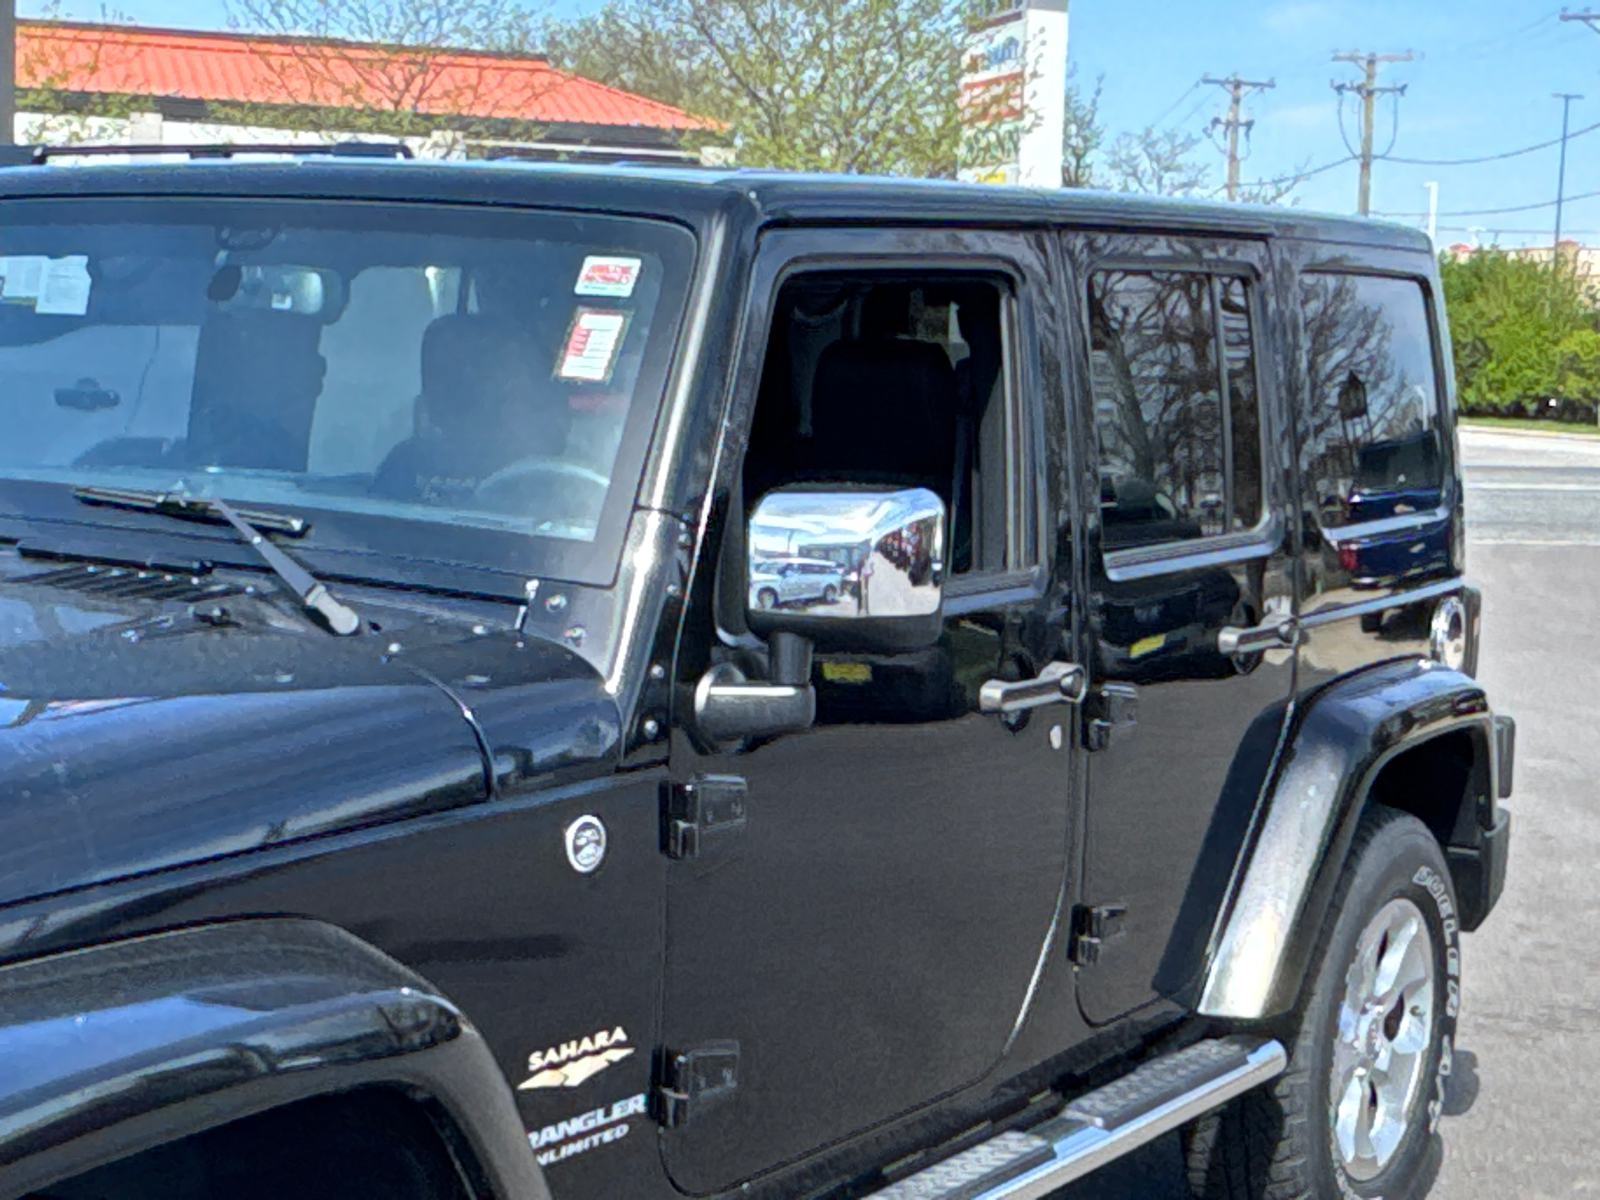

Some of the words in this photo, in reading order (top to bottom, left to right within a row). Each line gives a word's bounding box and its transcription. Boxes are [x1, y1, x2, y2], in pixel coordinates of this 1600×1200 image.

[528, 1026, 628, 1071] SAHARA
[528, 1093, 648, 1149] RANGLER
[537, 1123, 630, 1165] NLIMITED
